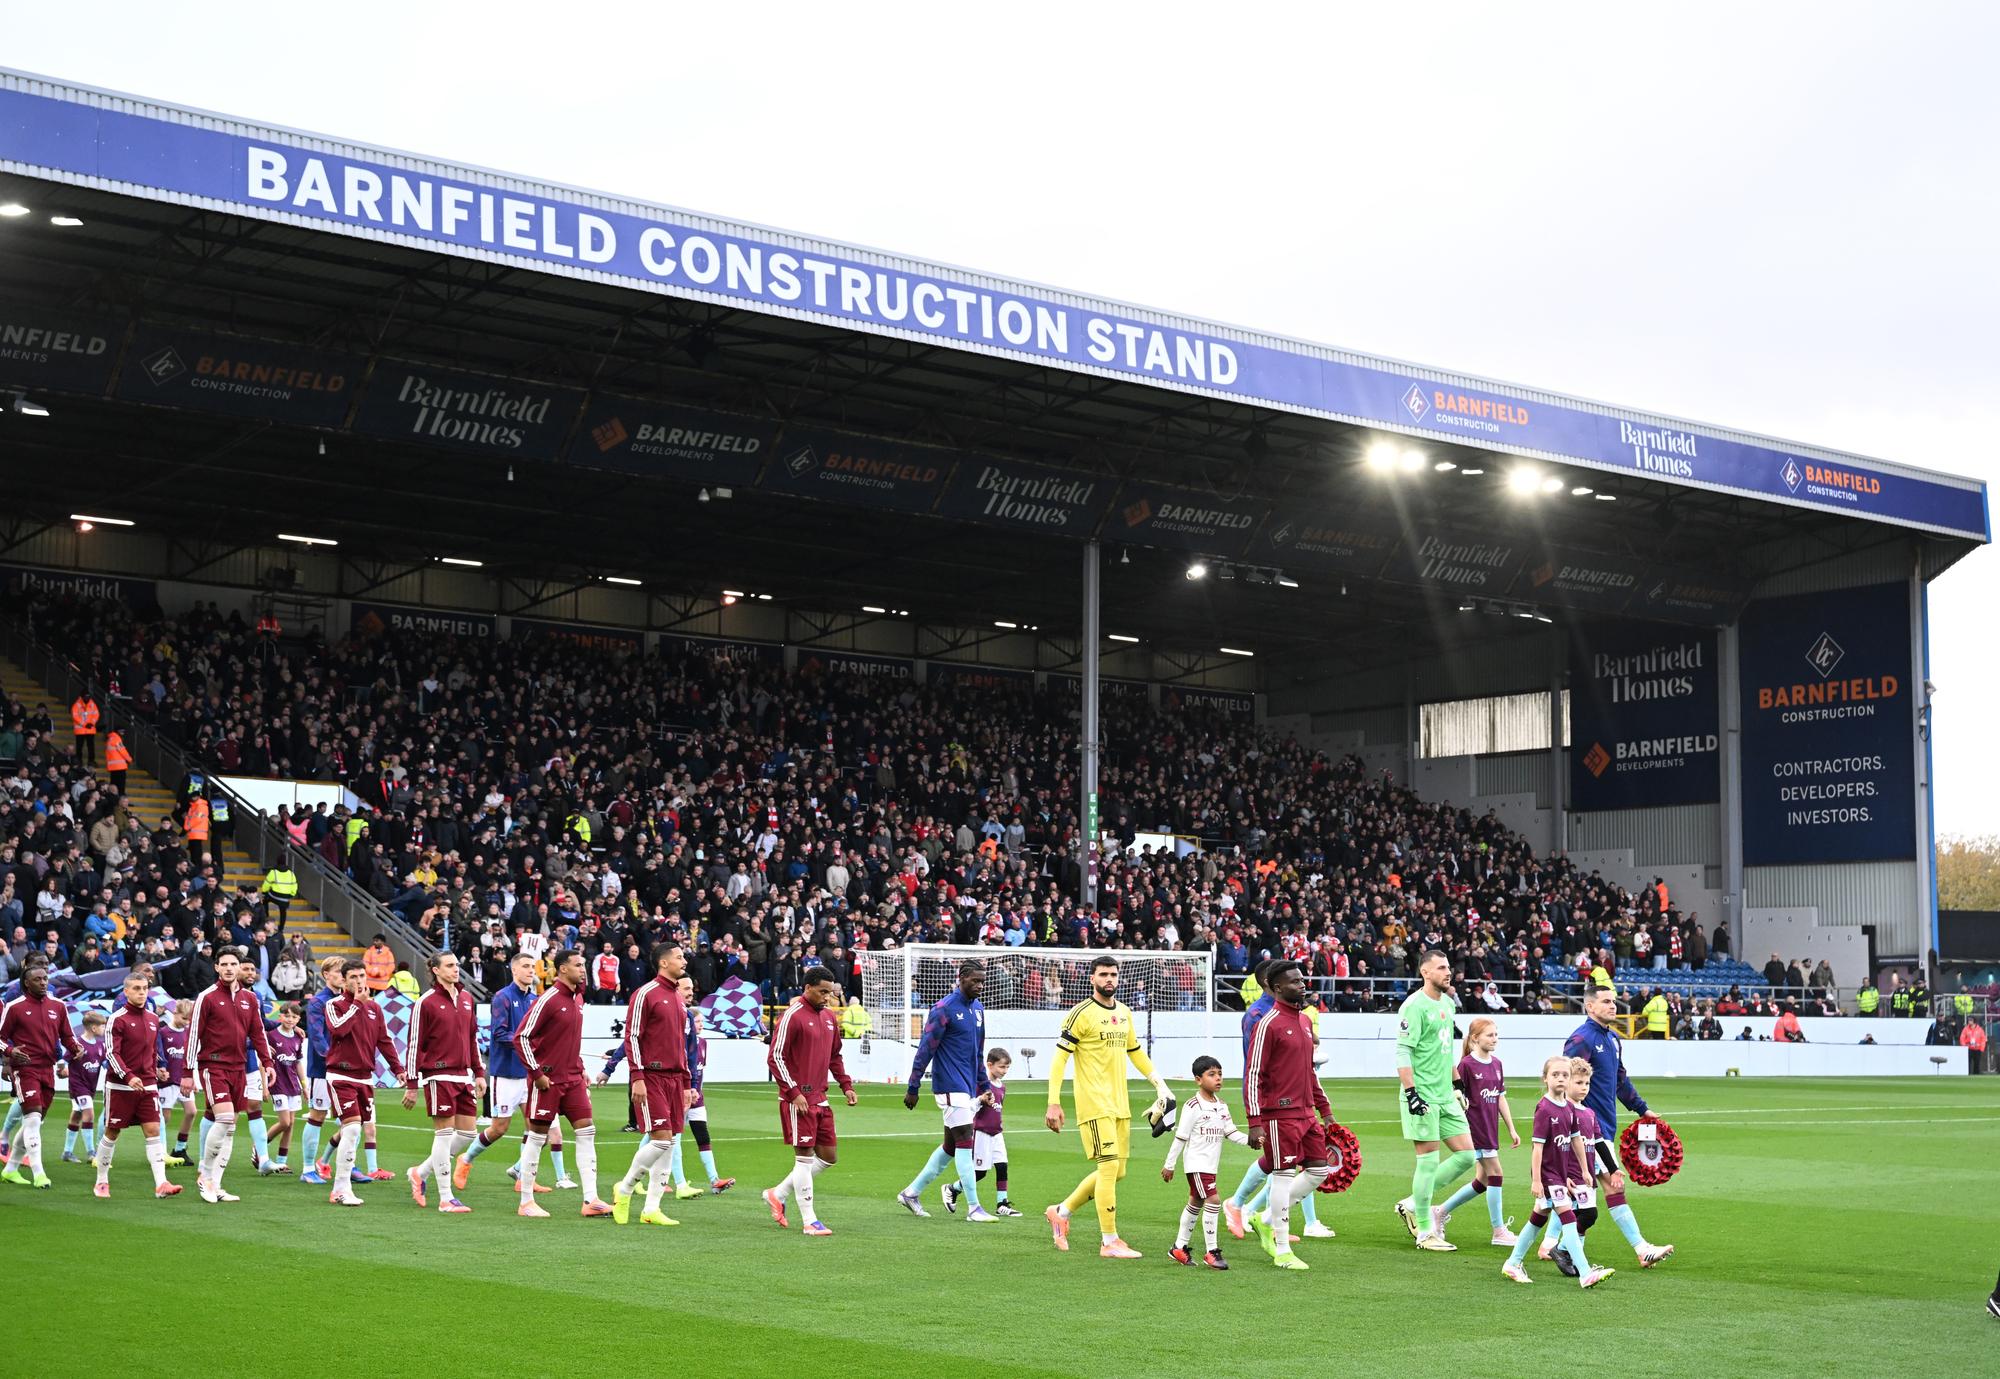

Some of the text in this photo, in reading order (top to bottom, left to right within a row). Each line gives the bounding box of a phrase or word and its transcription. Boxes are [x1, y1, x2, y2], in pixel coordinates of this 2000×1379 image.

[247, 147, 1239, 385] BARNFIELD CONSTRUCTION STAND
[0, 325, 107, 356] NFIELD
[196, 356, 345, 393] BARNFIELD
[191, 378, 292, 400] CONSTRUCTION
[398, 375, 551, 424] Barnfield
[1434, 391, 1529, 425] BARNFIELD
[413, 407, 525, 449] Homes
[1436, 413, 1500, 433] CONSTRUCTION
[636, 423, 760, 454] BARNFIELD
[1620, 421, 1697, 457] Barnfield
[631, 443, 715, 462] DEVELOPMENTS
[1635, 446, 1693, 477] Homes
[819, 472, 895, 489] CONSTRUCTION
[825, 454, 938, 483] BARNFIELD
[1805, 465, 1880, 494] BARNFIELD
[976, 466, 1095, 505] Barnfield
[1807, 485, 1857, 501] CONSTRUCTION
[984, 491, 1072, 526] Homes
[1158, 504, 1252, 529] BARNFIELD
[1151, 521, 1216, 536] DEVELOPMENTS
[1417, 536, 1512, 567] Barnfield
[1421, 558, 1486, 585] Homes
[1558, 566, 1634, 587] BARNFIELD
[1594, 641, 1702, 678] Barnfield
[1612, 676, 1694, 702] Homes
[1759, 676, 1898, 709] BARNFIELD
[1782, 705, 1875, 723] CONSTRUCTION
[1616, 735, 1718, 759] BARNFIELD
[1616, 758, 1685, 771] DEVELOPMENTS
[1773, 756, 1886, 777] CONTRACTORS.
[1781, 781, 1879, 801] DEVELOPERS.
[1788, 807, 1873, 825] INVESTORS.
[527, 936, 539, 951] 14
